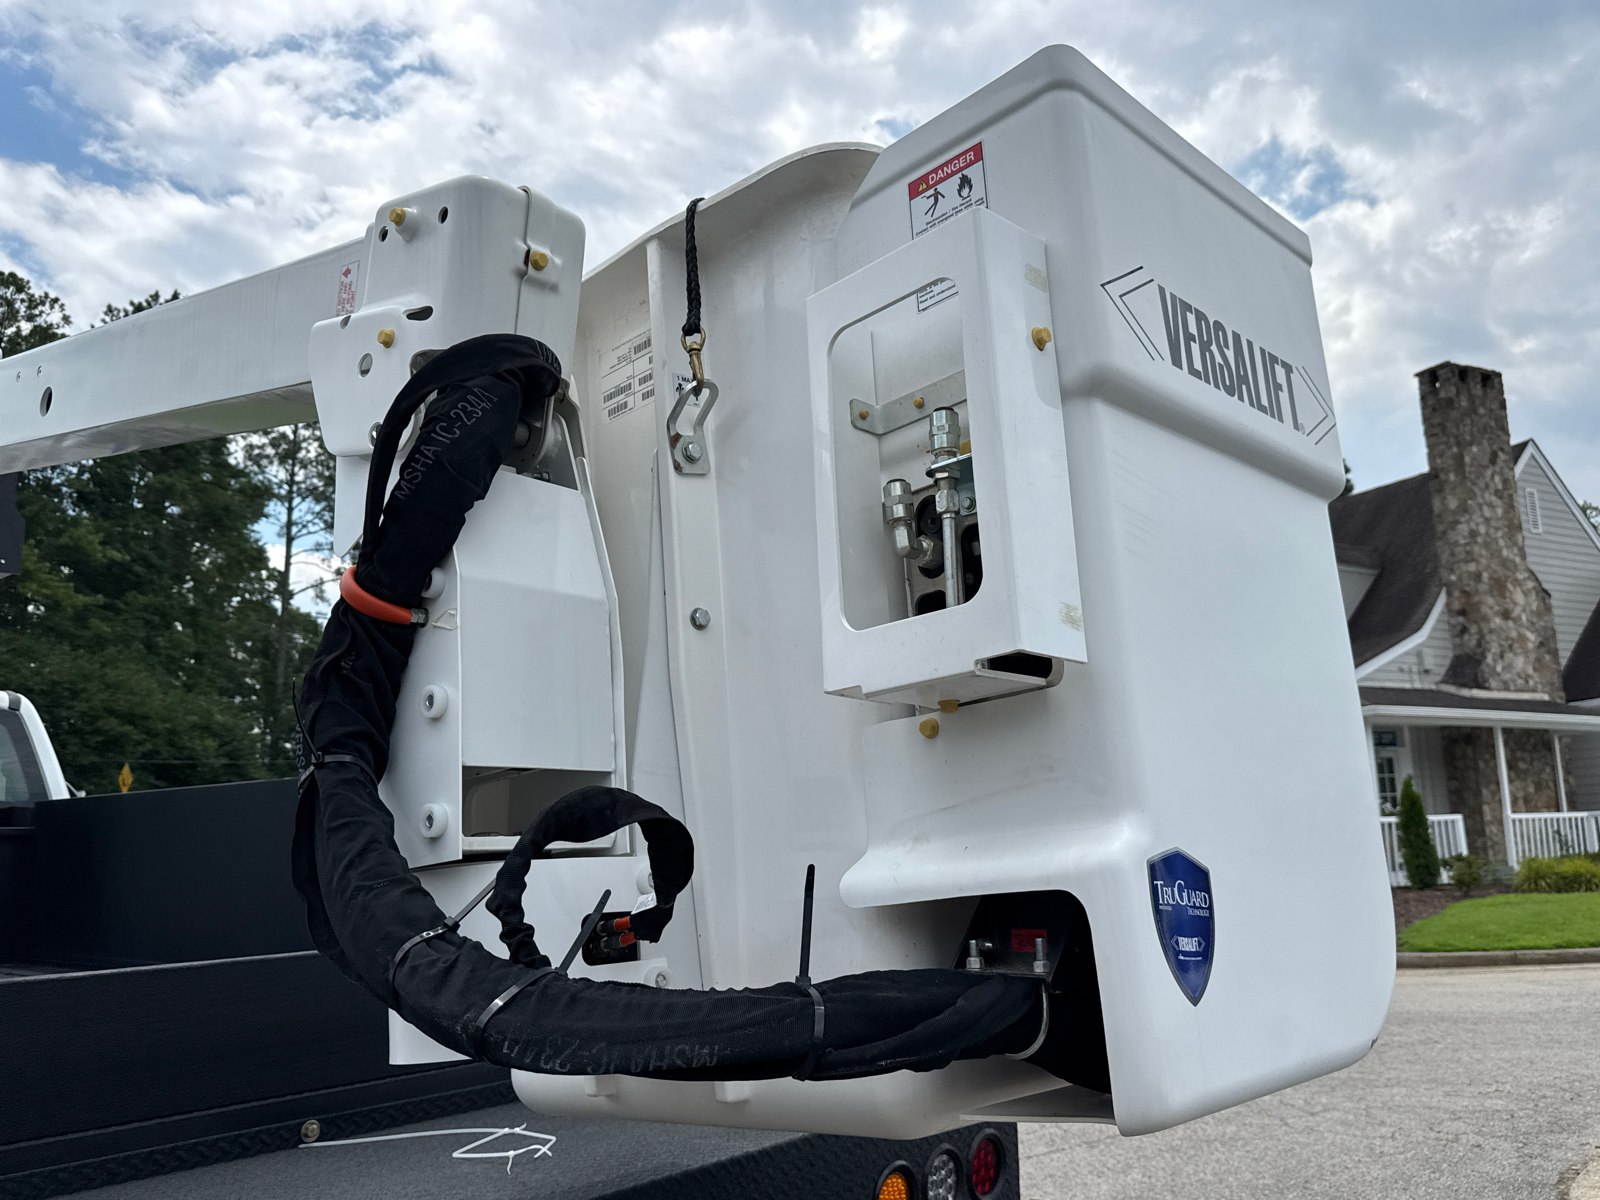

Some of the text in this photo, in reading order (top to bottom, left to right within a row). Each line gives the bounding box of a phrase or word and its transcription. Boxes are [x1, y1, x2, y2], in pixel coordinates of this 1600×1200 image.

[928, 151, 975, 185] DANGER
[1157, 283, 1300, 432] VERSALIFT
[394, 387, 499, 500] MSHA IC-234/1
